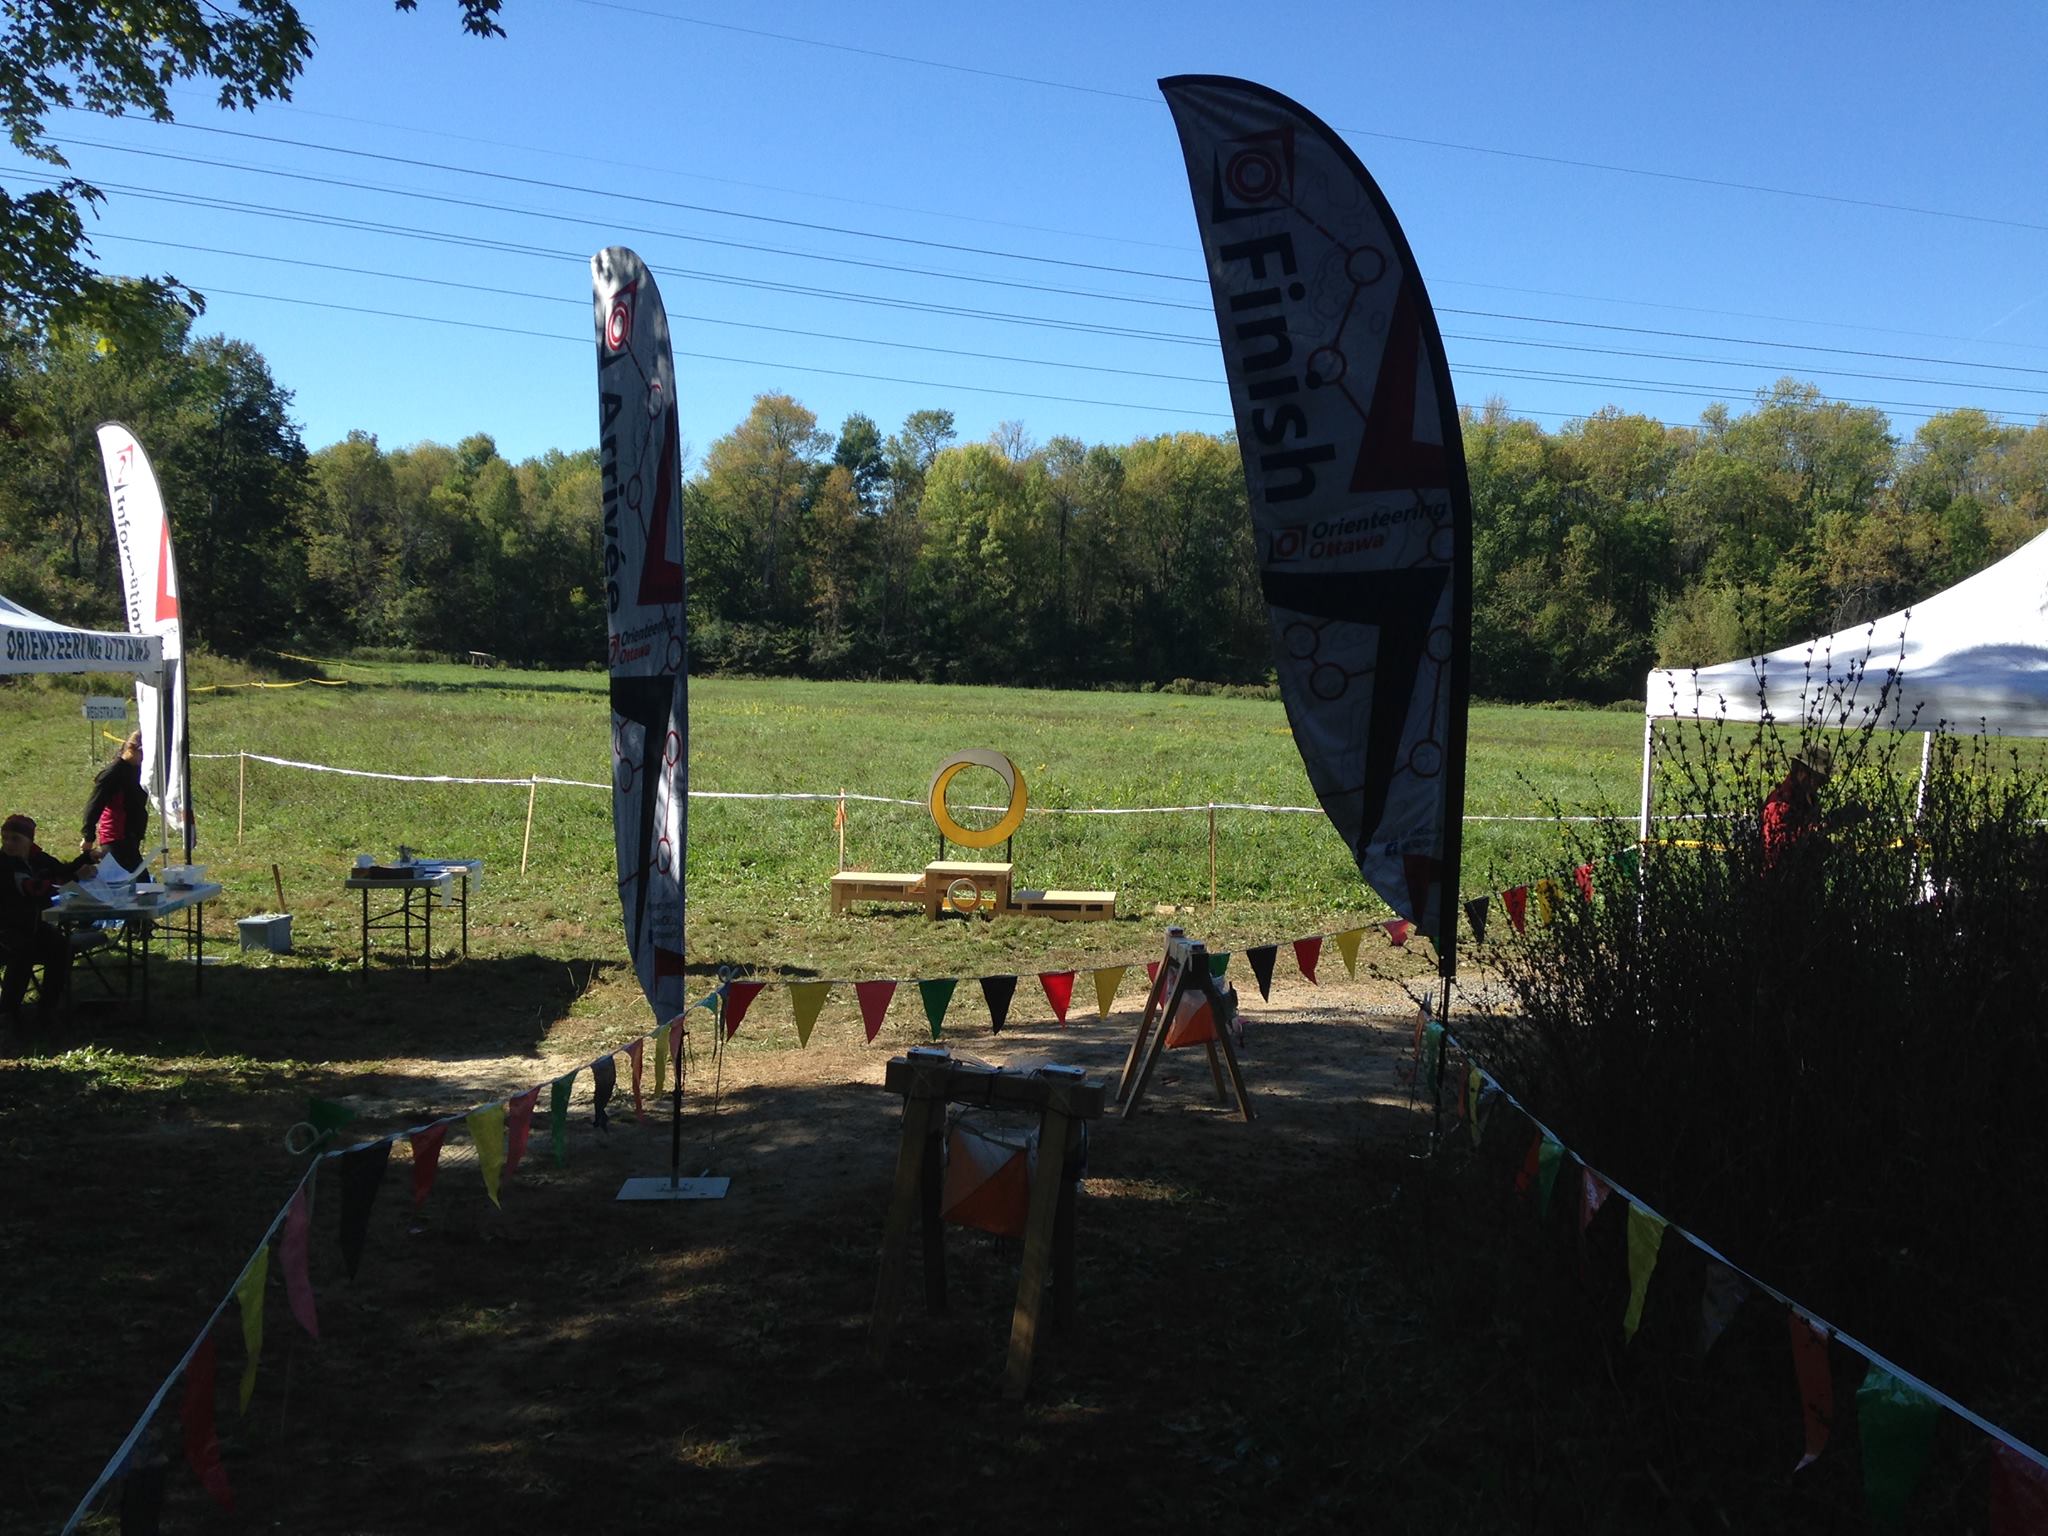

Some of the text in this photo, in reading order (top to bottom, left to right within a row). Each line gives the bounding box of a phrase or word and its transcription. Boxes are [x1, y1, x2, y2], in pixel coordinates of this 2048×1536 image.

[1219, 231, 1337, 504] Finish
[600, 391, 627, 614] Arrivée
[1308, 533, 1385, 560] Ottawa
[1311, 502, 1447, 539] Orienteering
[115, 494, 144, 635] Information
[6, 629, 150, 662] ORIENTEERING OTTAWA
